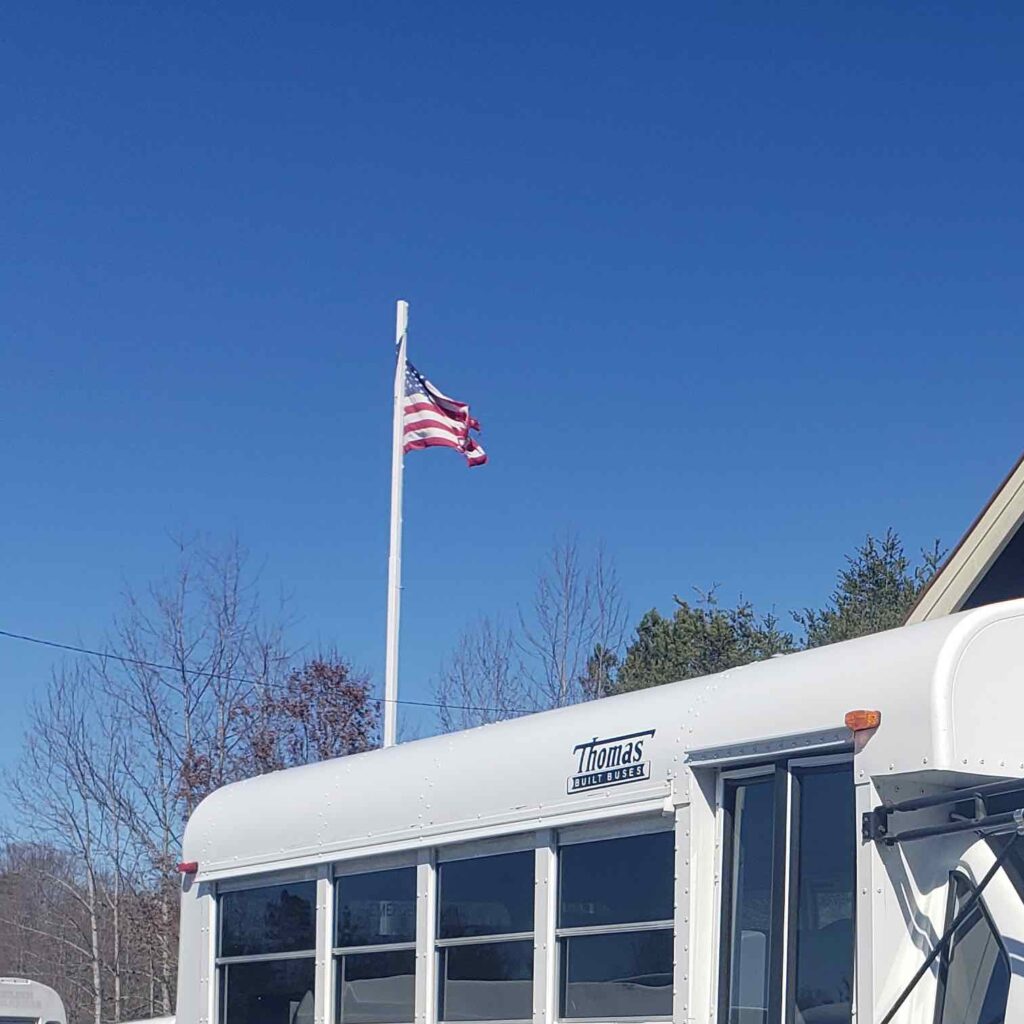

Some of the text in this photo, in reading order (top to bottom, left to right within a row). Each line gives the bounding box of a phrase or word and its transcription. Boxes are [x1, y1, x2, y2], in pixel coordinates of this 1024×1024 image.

[573, 729, 656, 774] Thomas
[574, 765, 642, 788] BUILT BUSES
